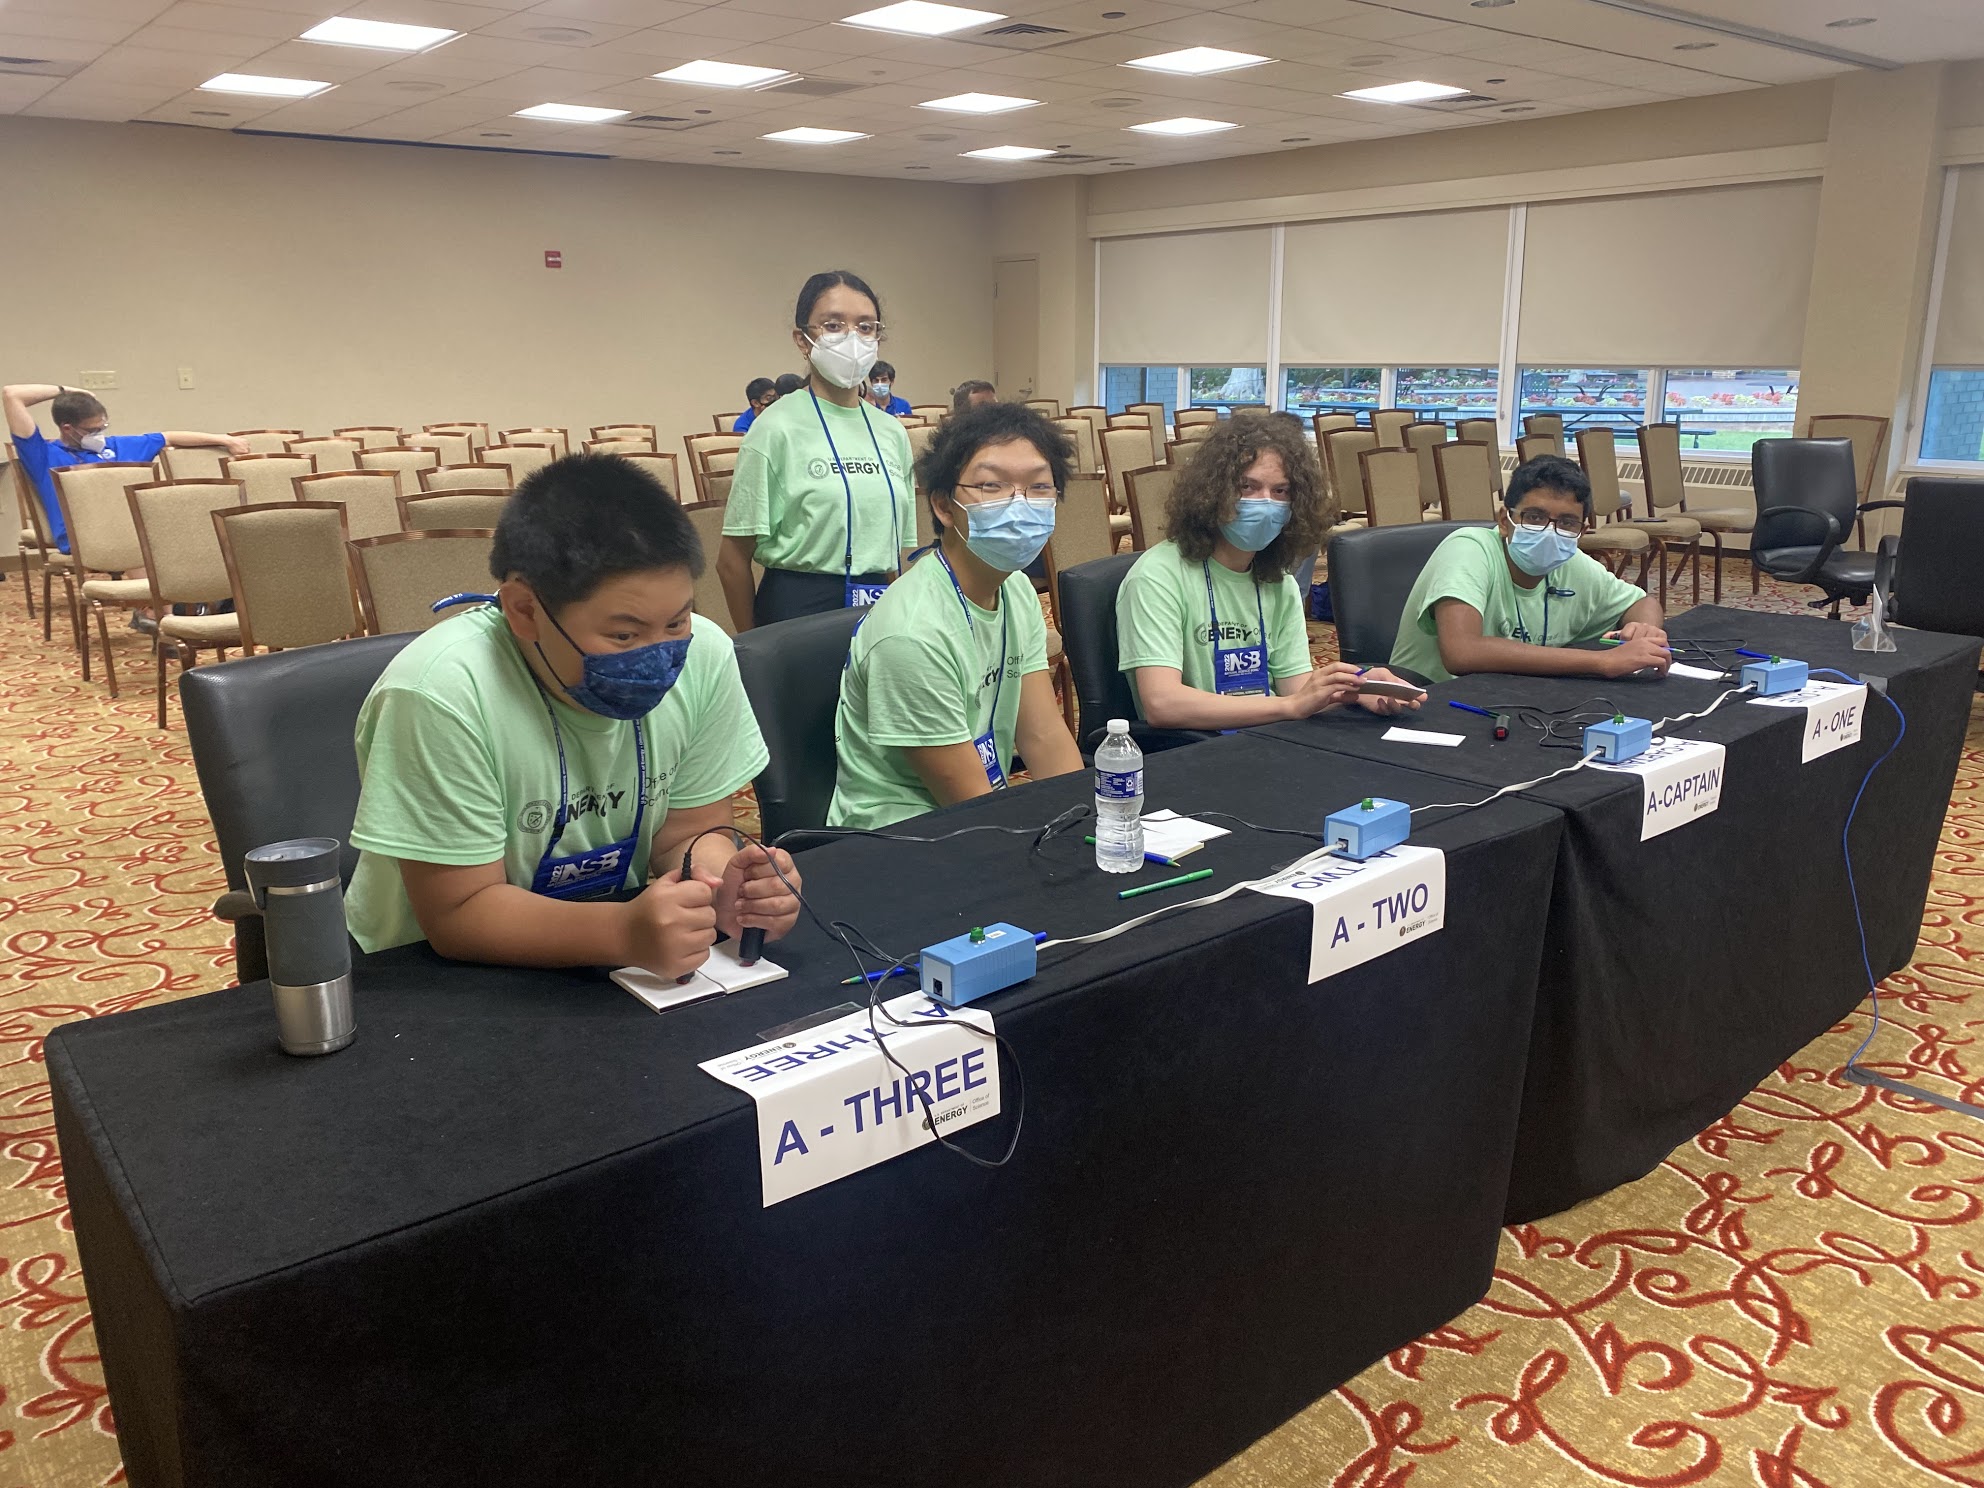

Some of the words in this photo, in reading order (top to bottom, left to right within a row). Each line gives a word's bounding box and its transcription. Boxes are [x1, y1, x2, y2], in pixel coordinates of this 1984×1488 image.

[830, 462, 880, 474] ENERGY
[859, 589, 886, 606] NS
[1230, 651, 1261, 671] NSB
[1812, 718, 1820, 740] A
[1831, 706, 1856, 732] ONE
[1647, 767, 1720, 815] A-CAPTAIN
[560, 850, 620, 880] NSB
[1291, 867, 1367, 889] TWO
[1331, 916, 1350, 949] A
[1372, 883, 1428, 929] TWO
[911, 1003, 949, 1018] A
[731, 1028, 898, 1082] THREE
[745, 1046, 782, 1060] ENERGY
[774, 1120, 809, 1165] A
[844, 1048, 986, 1134] THREE
[935, 1106, 968, 1125] ENERGY
